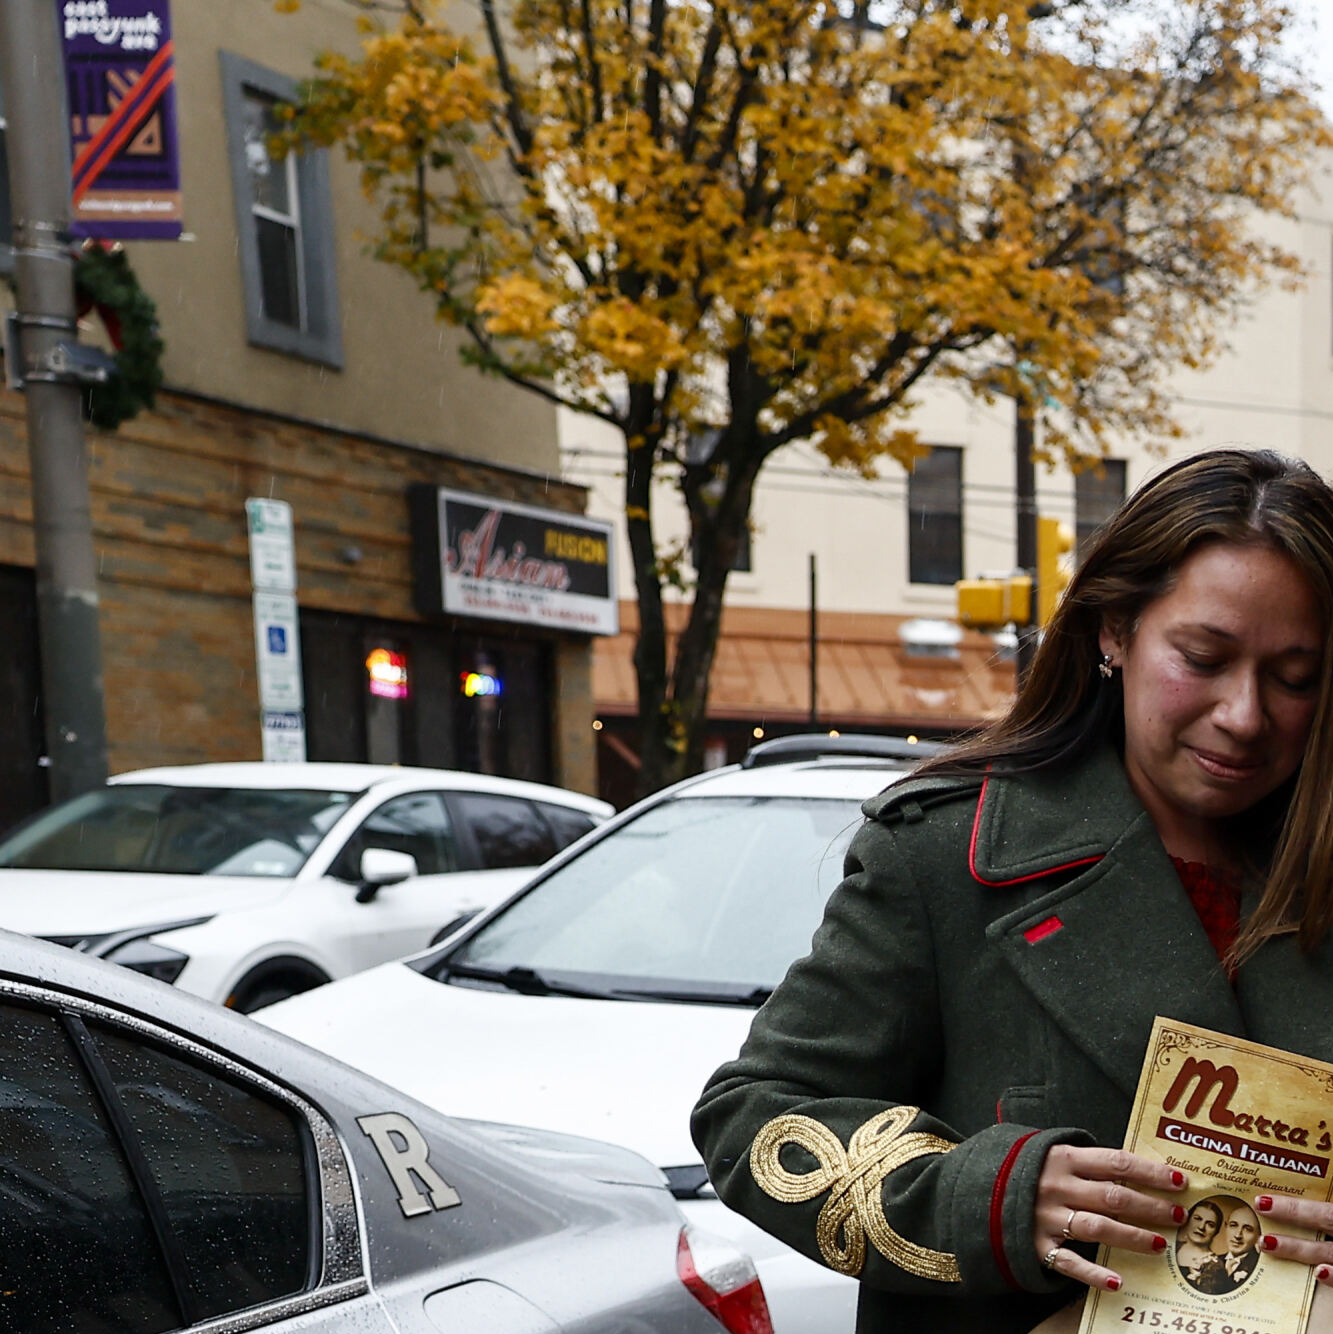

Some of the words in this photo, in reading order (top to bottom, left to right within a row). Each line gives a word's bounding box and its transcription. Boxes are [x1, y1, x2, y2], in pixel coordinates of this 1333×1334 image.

[446, 508, 571, 592] Asian
[544, 529, 608, 566] FUSION
[1162, 1056, 1332, 1151] Marra's
[355, 1111, 462, 1219] R
[1164, 1124, 1233, 1155] CUCINA
[1239, 1143, 1322, 1176] ITALIANA
[1216, 1158, 1260, 1176] Original
[1165, 1156, 1200, 1172] Italian
[1202, 1166, 1248, 1184] American
[1250, 1177, 1306, 1196] Restaurant
[1177, 1281, 1209, 1303] Salvatore
